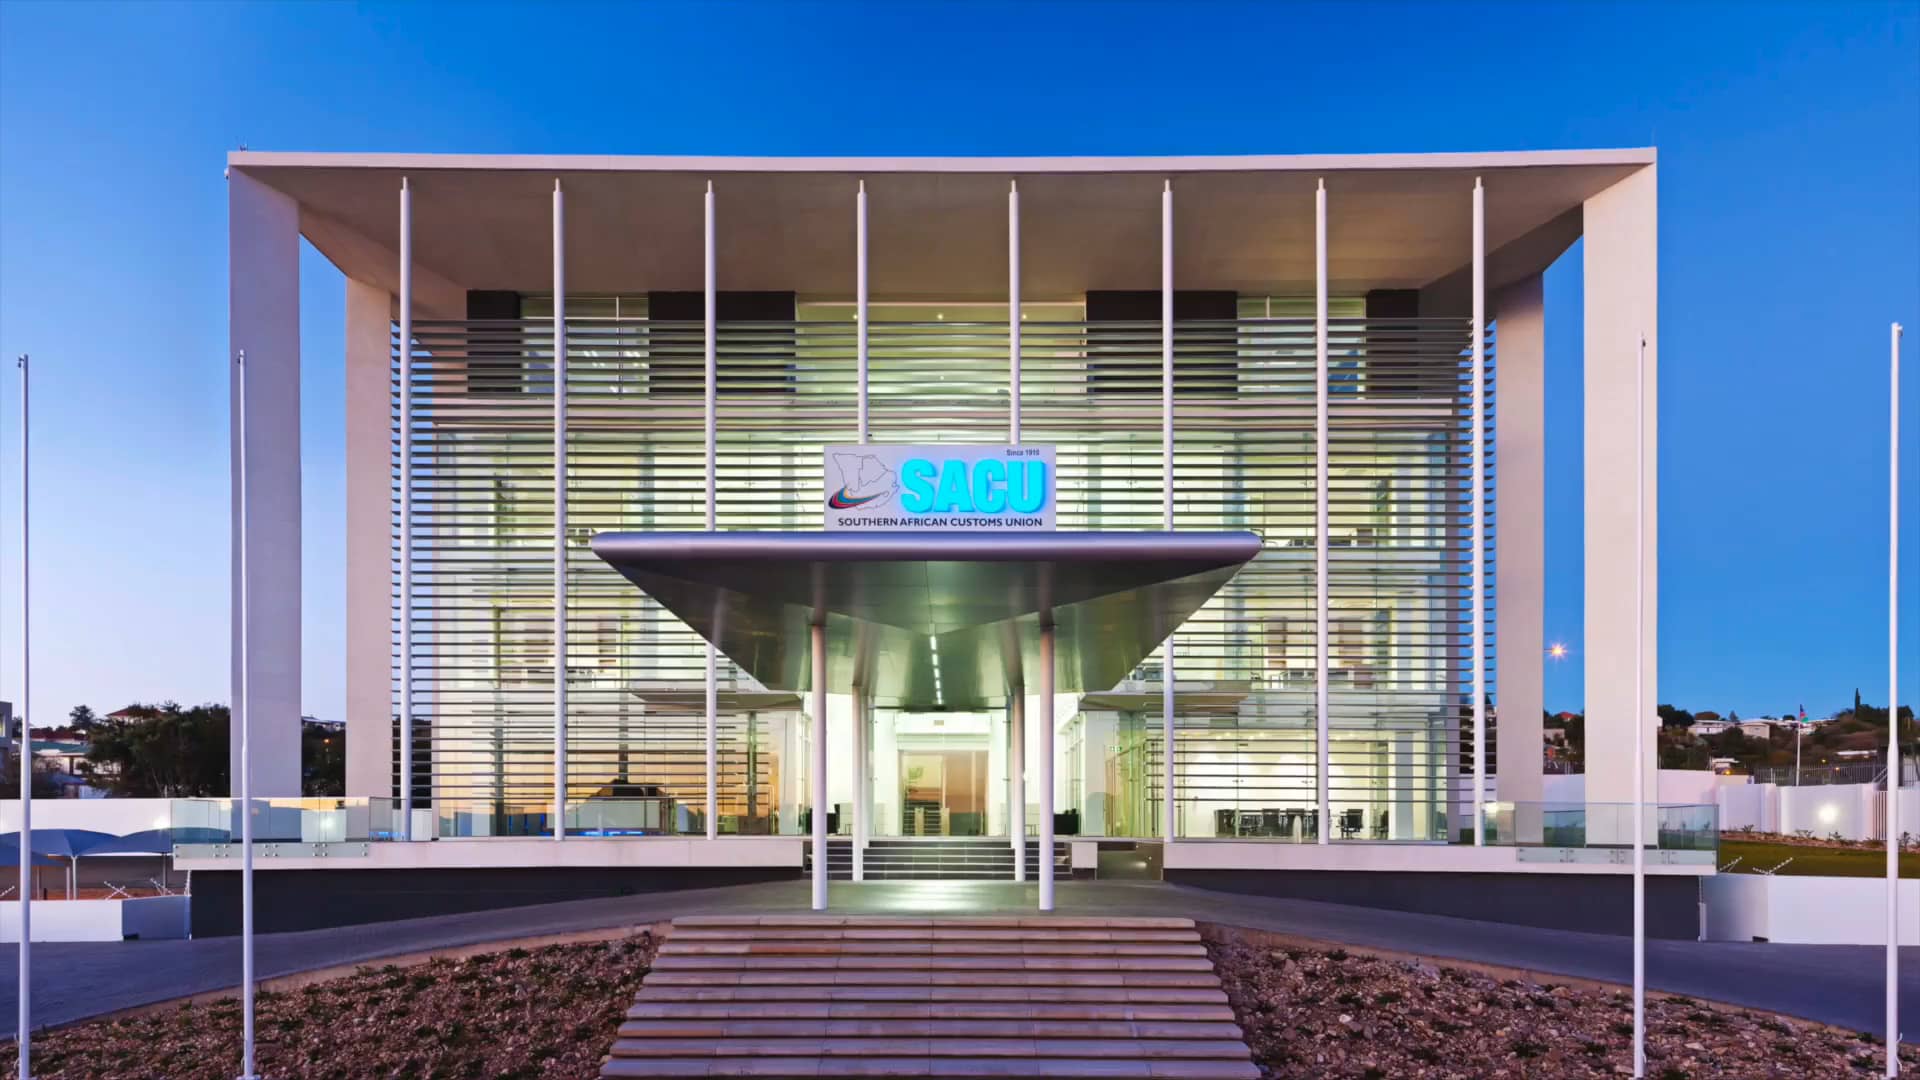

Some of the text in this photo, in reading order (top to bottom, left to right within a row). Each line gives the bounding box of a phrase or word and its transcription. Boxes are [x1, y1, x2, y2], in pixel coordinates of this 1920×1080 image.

[1006, 448, 1024, 456] Since
[901, 458, 1046, 514] SACU
[838, 517, 1042, 527] SOUTHERN AFRICAN CUSTOMS UNION
